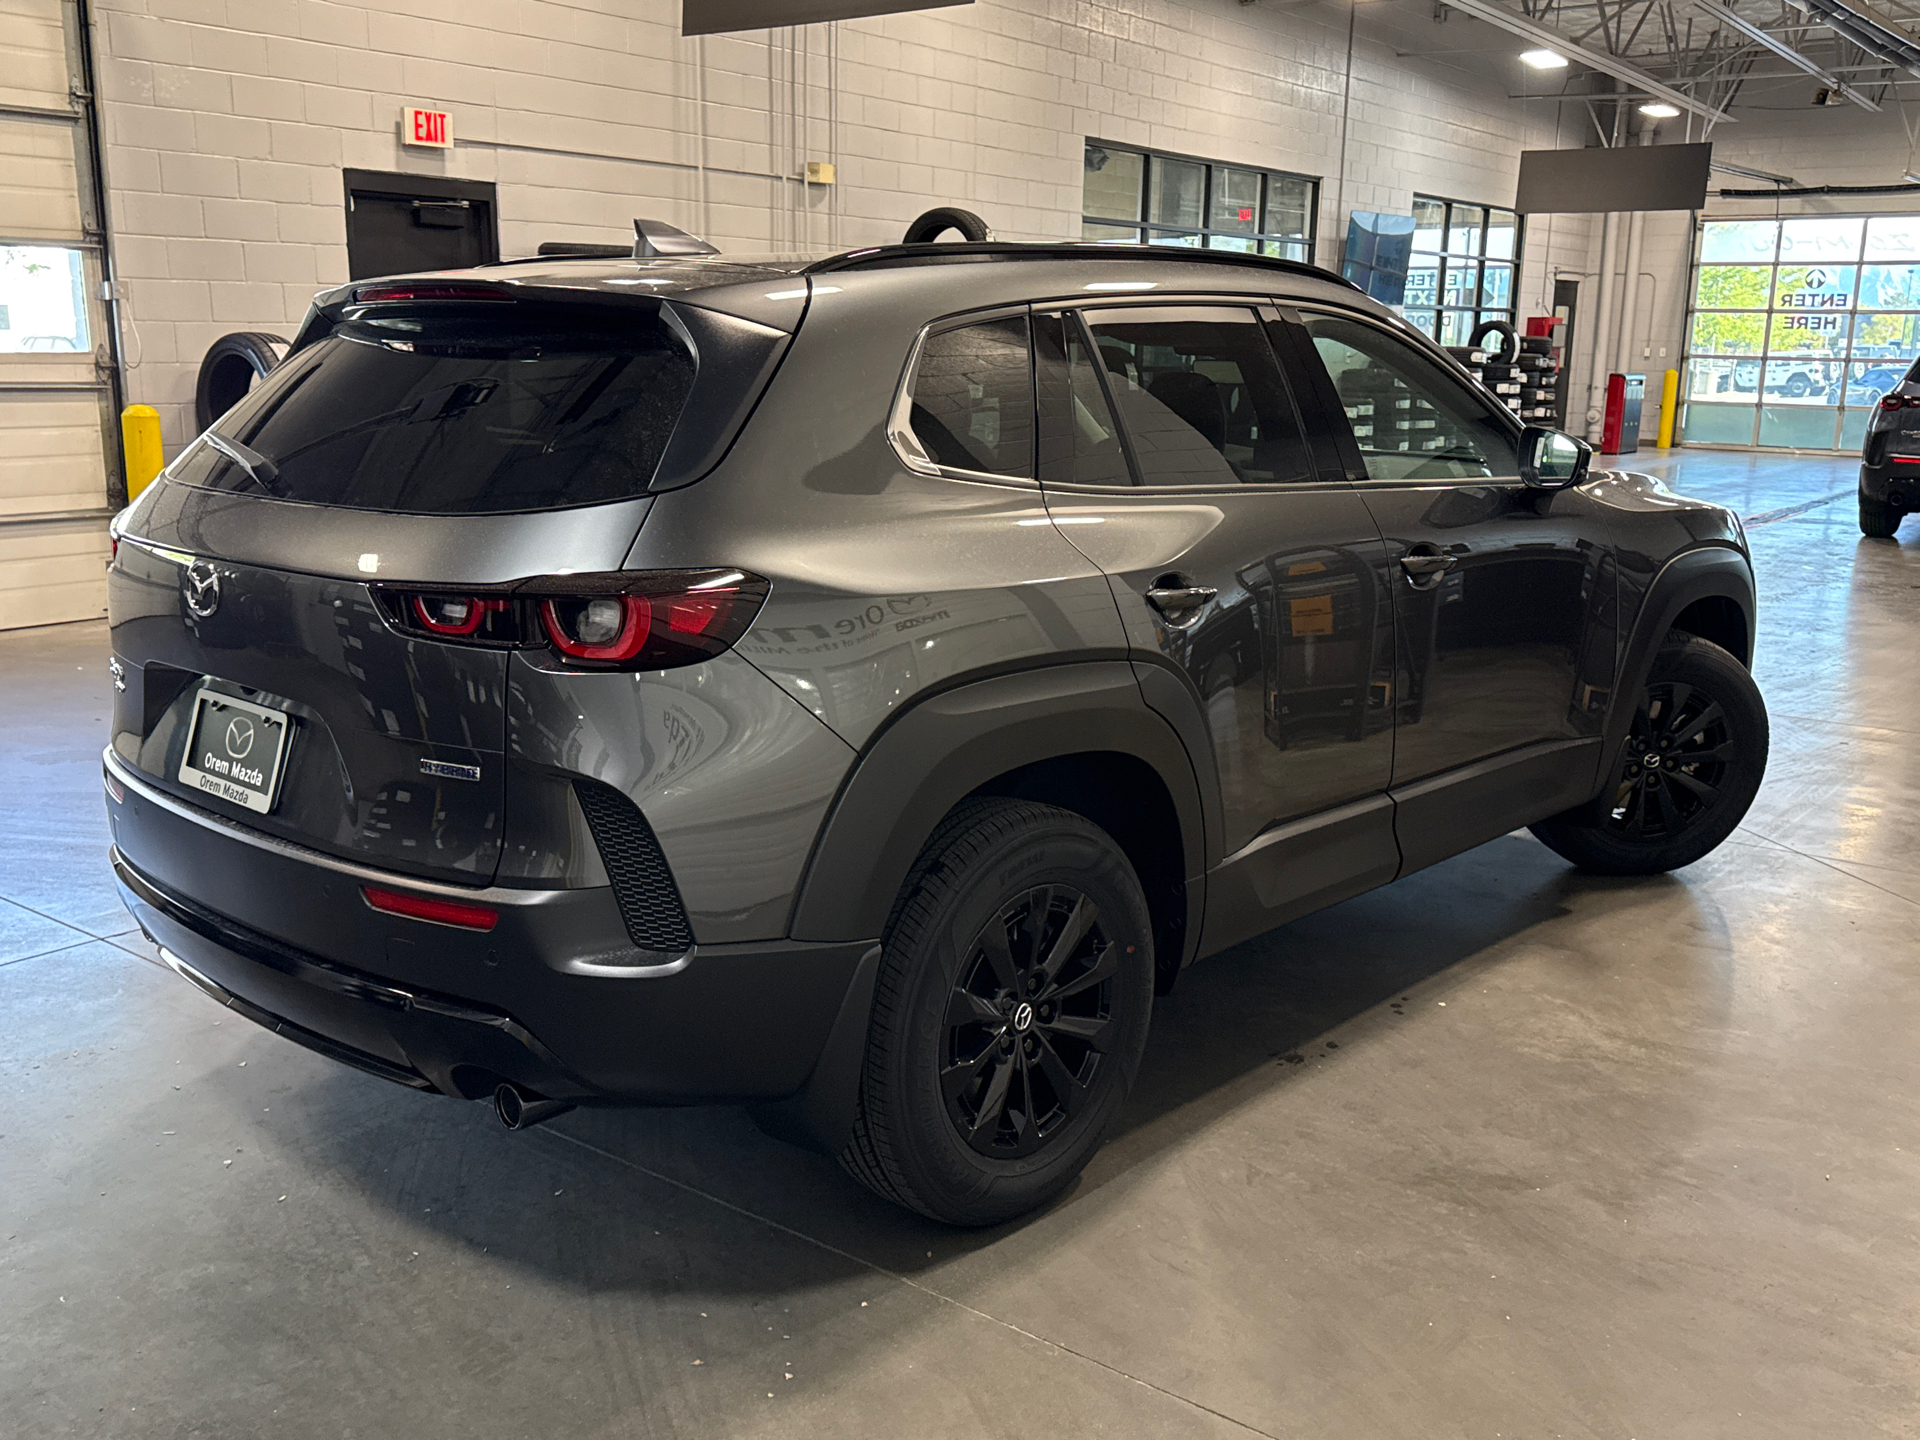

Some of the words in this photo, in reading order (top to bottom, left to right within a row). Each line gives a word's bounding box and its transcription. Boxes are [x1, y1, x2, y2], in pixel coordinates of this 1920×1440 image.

[414, 110, 446, 144] EXIT
[204, 752, 230, 775] Orem
[231, 761, 263, 787] Mazda
[200, 775, 221, 794] Orem
[222, 784, 249, 805] Mazda
